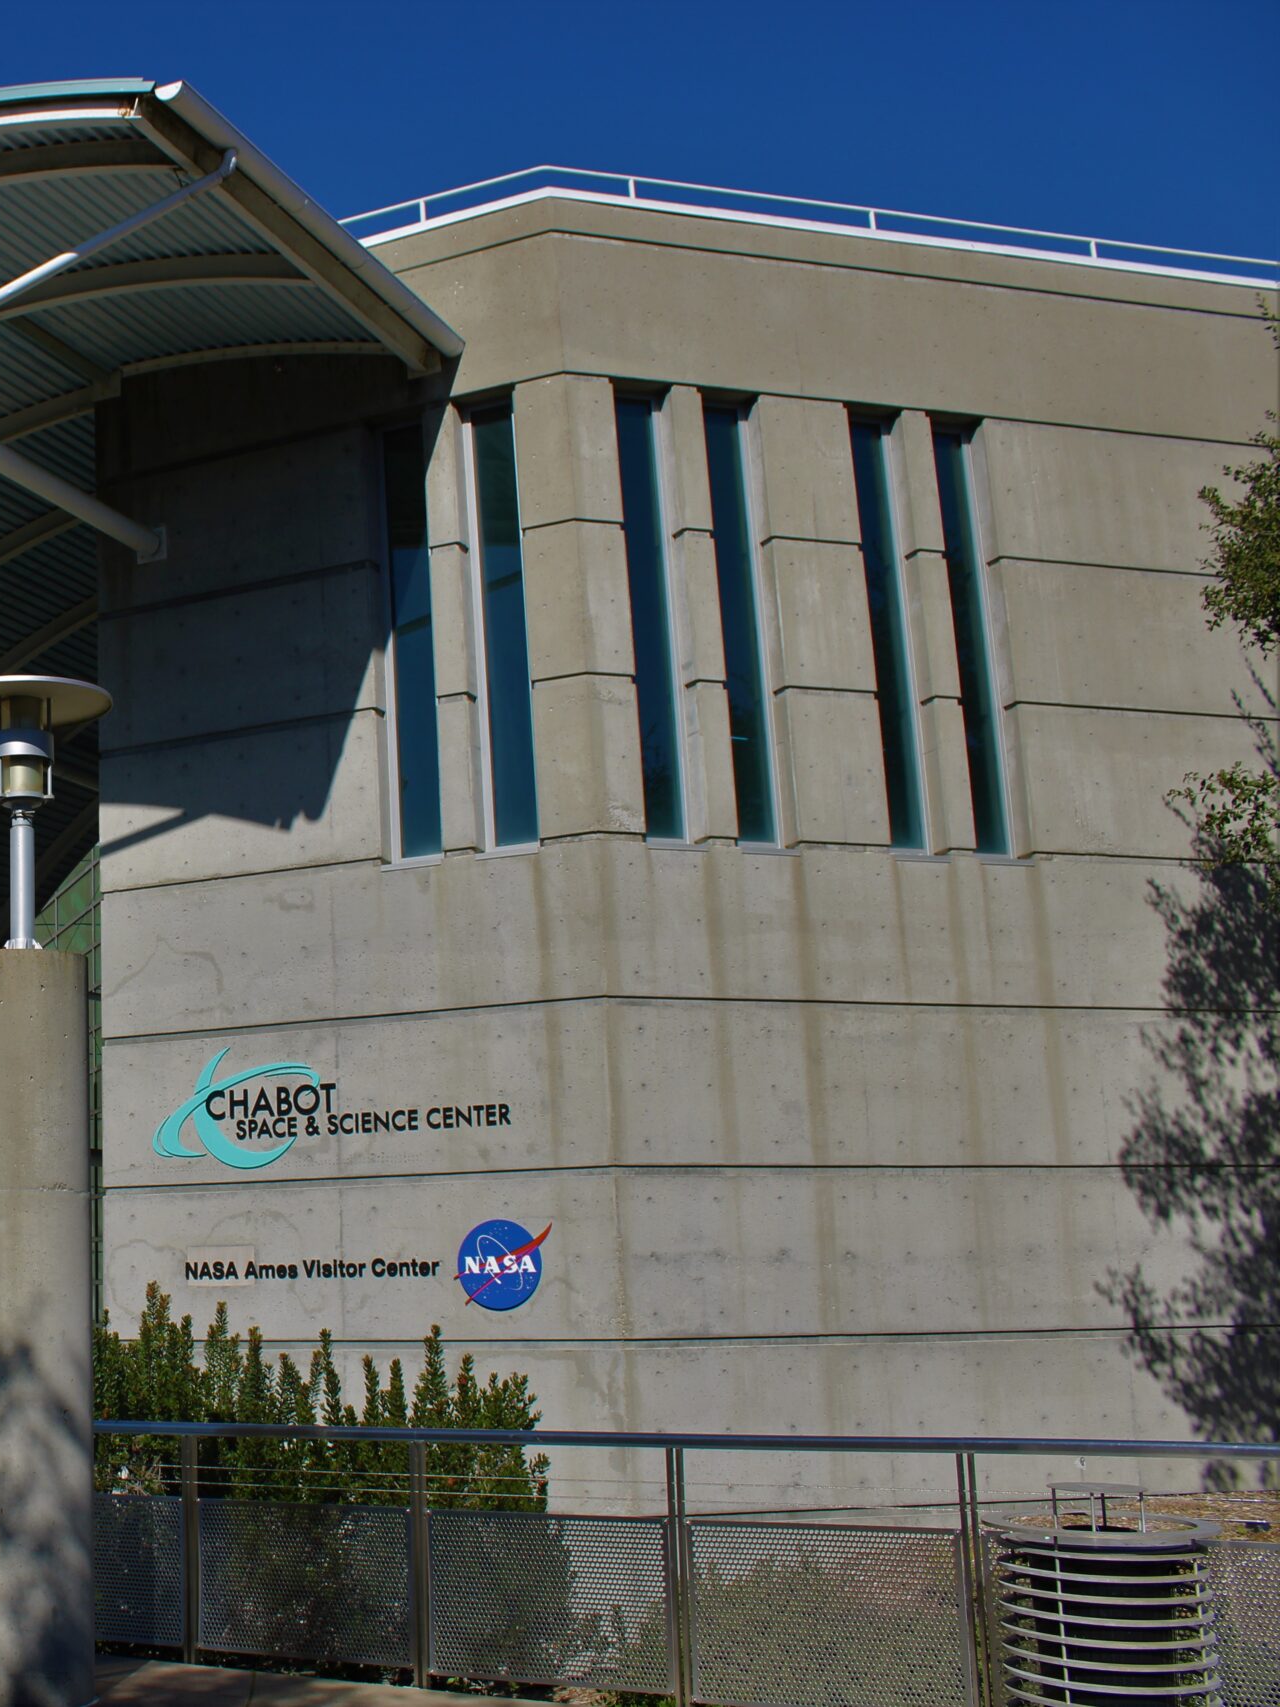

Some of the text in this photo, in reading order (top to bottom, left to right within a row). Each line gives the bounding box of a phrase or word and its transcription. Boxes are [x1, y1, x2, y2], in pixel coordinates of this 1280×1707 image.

[205, 1083, 336, 1121] CHABOT
[236, 1103, 511, 1141] SPACE & SCIENCE CENTER
[185, 1257, 440, 1281] NASA Ames Visitor Center
[464, 1255, 537, 1275] NASA
